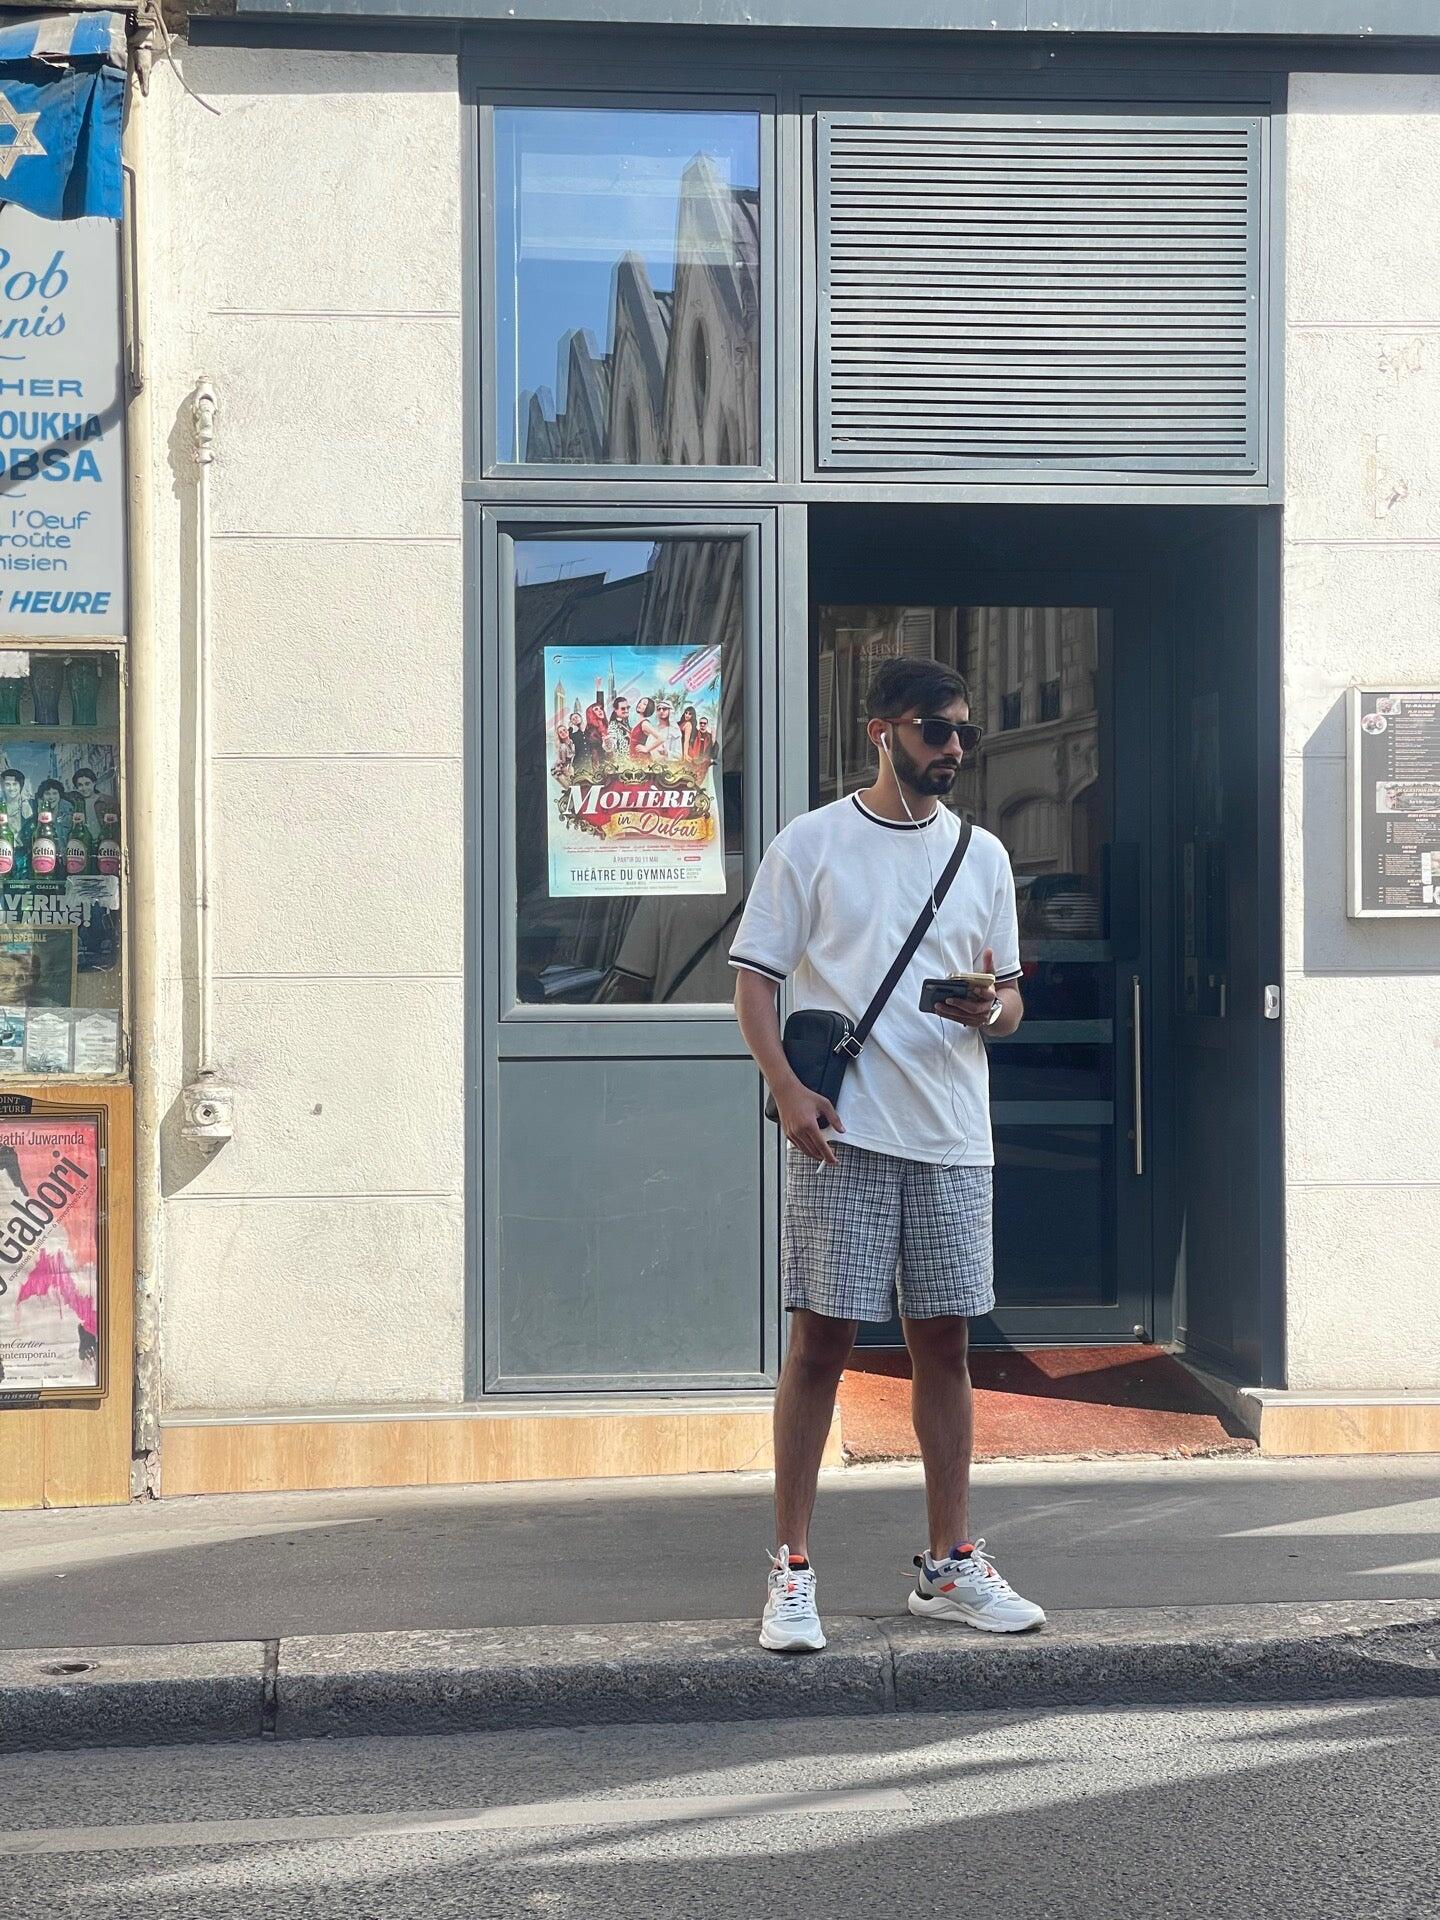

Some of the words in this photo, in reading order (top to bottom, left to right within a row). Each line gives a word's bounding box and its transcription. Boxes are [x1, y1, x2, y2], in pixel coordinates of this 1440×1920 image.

[0, 305, 66, 339] nis
[9, 591, 111, 614] HEURE
[564, 785, 697, 815] MOLIÈRE
[617, 814, 631, 826] in
[571, 869, 616, 882] THÉÂTRE
[620, 869, 633, 880] DU
[637, 867, 686, 880] GYMNASE
[28, 1131, 84, 1145] Juwarnda
[0, 1151, 89, 1265] Gabori
